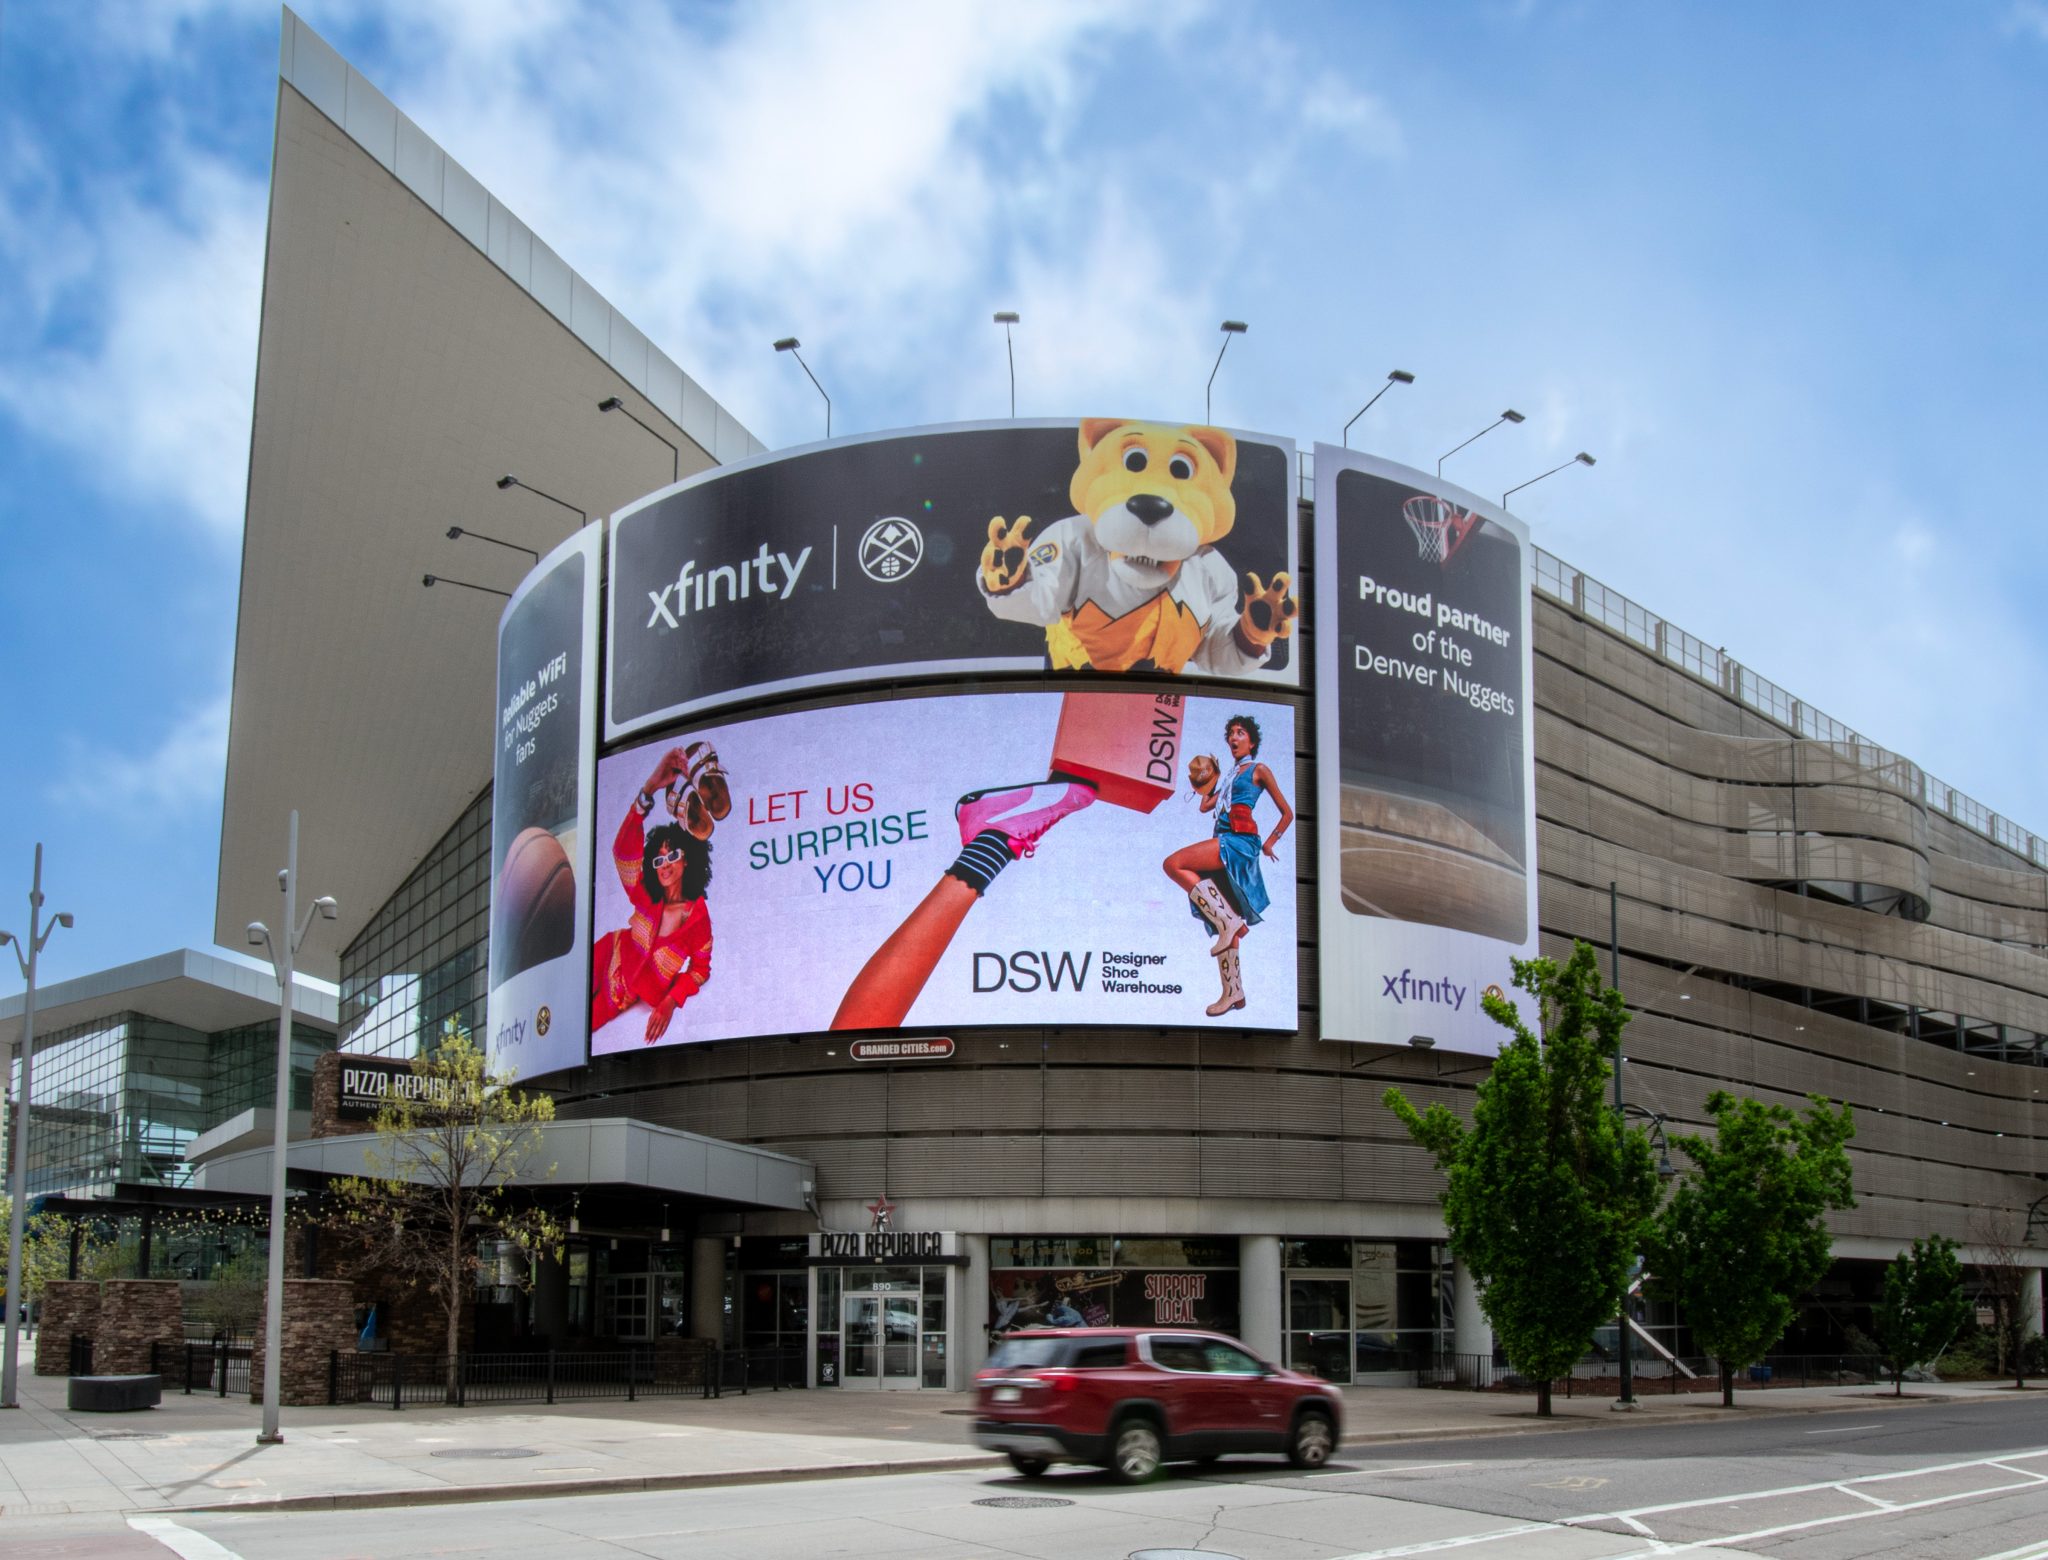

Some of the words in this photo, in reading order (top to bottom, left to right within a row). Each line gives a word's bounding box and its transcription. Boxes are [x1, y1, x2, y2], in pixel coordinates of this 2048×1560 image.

[646, 543, 813, 629] xfinity
[1359, 575, 1432, 617] Proud
[1437, 603, 1510, 648] partner
[1412, 630, 1436, 654] of
[1439, 637, 1472, 667] the
[502, 680, 537, 729] Reliable
[538, 651, 567, 689] WiFi
[1355, 645, 1438, 687] Denver
[1443, 668, 1515, 716] Nuggets
[504, 727, 516, 752] for
[515, 693, 558, 738] Nuggets
[515, 737, 536, 766] fans
[1146, 707, 1178, 784] DSW
[749, 789, 808, 825] LET
[826, 783, 875, 816] US
[749, 809, 929, 870] SURPRISE
[814, 859, 891, 894] YOU
[972, 950, 1092, 993] DSW
[1102, 951, 1167, 967] Designer
[1102, 966, 1139, 979] Shoe
[1102, 980, 1183, 994] Warehouse
[1382, 968, 1467, 1012] xfinity
[495, 1017, 527, 1055] xfinity
[859, 1044, 900, 1056] BRANDED
[901, 1042, 947, 1054] CITIES.com
[343, 1068, 388, 1096] PIZZA
[820, 1232, 860, 1257] PIZZA
[865, 1231, 942, 1257] REPUBLICA
[872, 1282, 891, 1291] 890
[1144, 1273, 1207, 1299] SUPPORT
[1155, 1298, 1199, 1324] LOCAL
